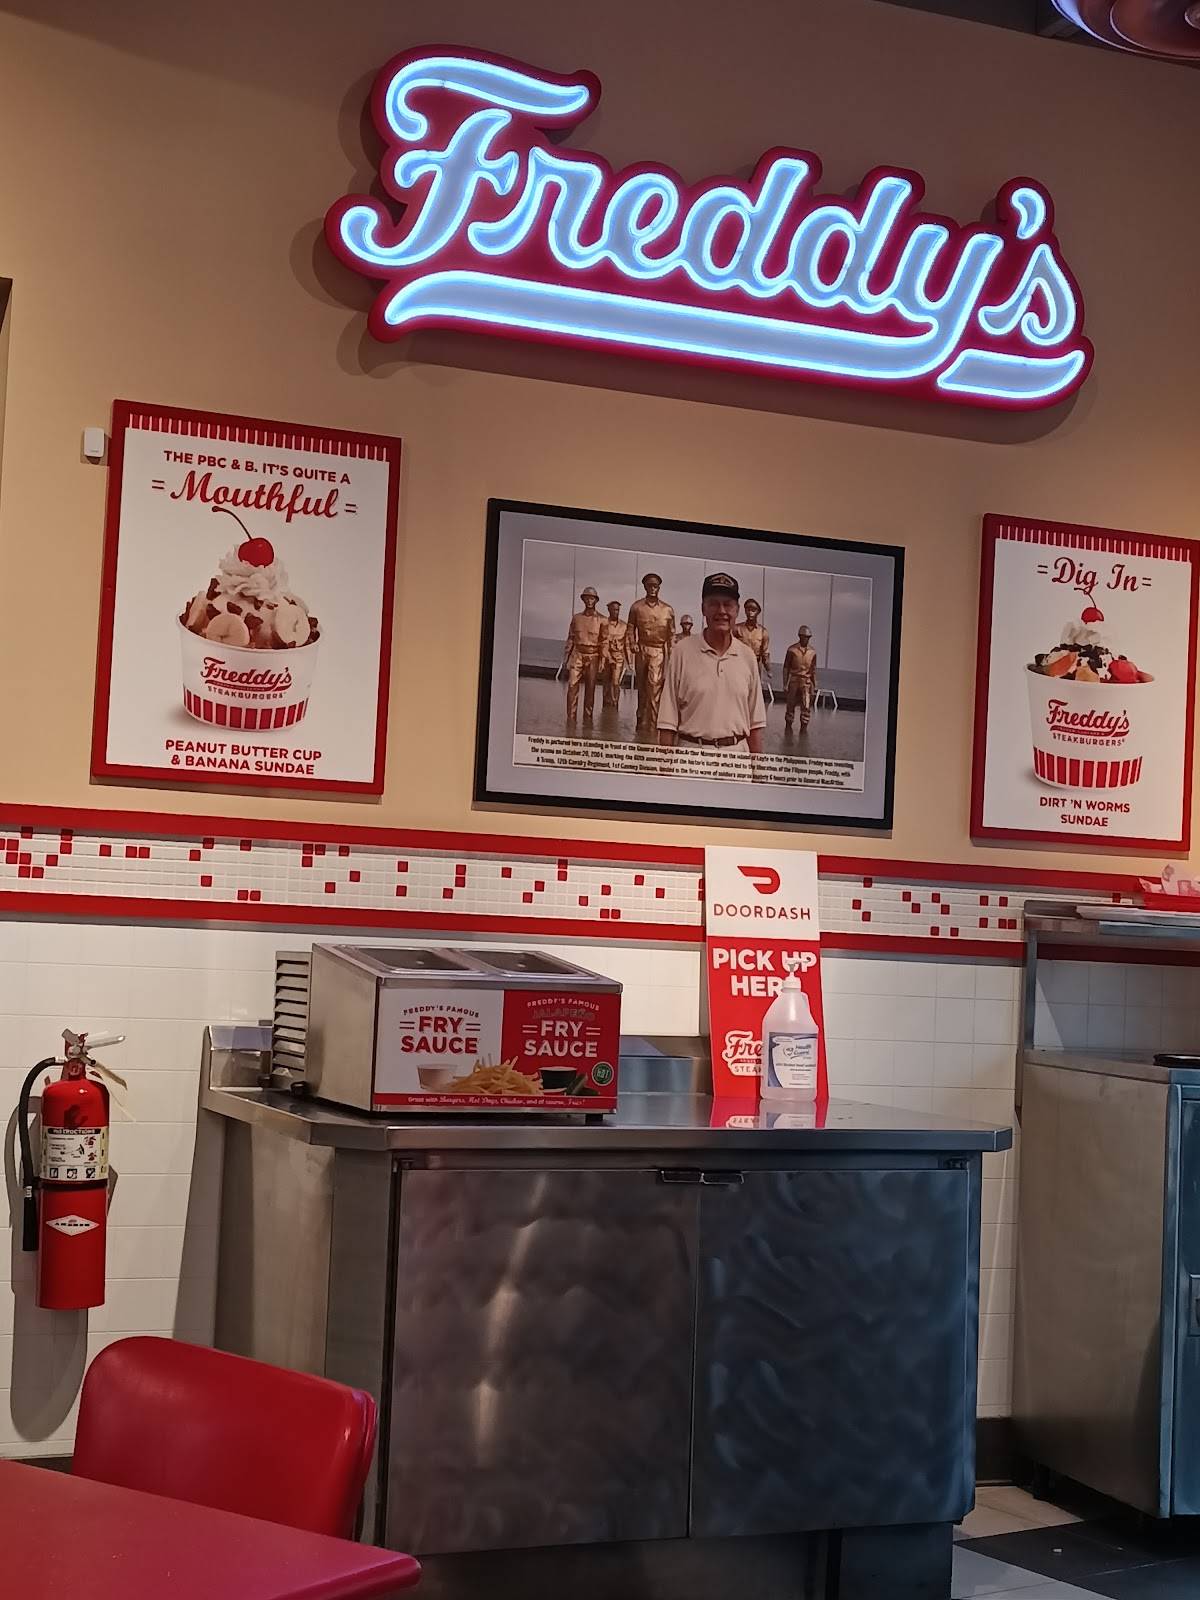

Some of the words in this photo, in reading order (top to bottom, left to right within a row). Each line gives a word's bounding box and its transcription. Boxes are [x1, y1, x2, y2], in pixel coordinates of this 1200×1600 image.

[340, 56, 1085, 398] Freddy's
[164, 450, 193, 464] THE
[198, 454, 226, 468] PBC
[231, 459, 240, 470] &
[245, 461, 258, 472] B.
[263, 463, 288, 476] IT'S
[293, 467, 336, 482] QUITE
[340, 474, 351, 484] A
[170, 470, 339, 522] Mouthful
[1052, 557, 1098, 595] Dig
[1107, 564, 1139, 592] In
[200, 657, 291, 692] Freddy's
[1046, 699, 1129, 737] Freddy's
[166, 740, 227, 754] PEANUT
[231, 744, 288, 758] BUTTER
[293, 750, 322, 760] CUP
[171, 754, 180, 765] &
[186, 756, 250, 770] BANANA
[255, 761, 314, 774] SUNDAE
[1040, 797, 1067, 808] DIRT
[1071, 800, 1081, 809] 'N
[1086, 800, 1130, 813] WORMS
[1061, 814, 1108, 826] SUNDAE
[714, 904, 810, 920] DOORDASH
[713, 948, 775, 971] PICK
[782, 951, 817, 973] UP
[731, 975, 783, 997] HER
[446, 1006, 479, 1018] FAMOUS
[568, 998, 600, 1011] FAMOUS
[419, 1016, 463, 1033] FRY
[541, 1020, 583, 1037] FRY
[401, 1036, 478, 1054] SAUCE
[524, 1039, 597, 1058] SAUCE
